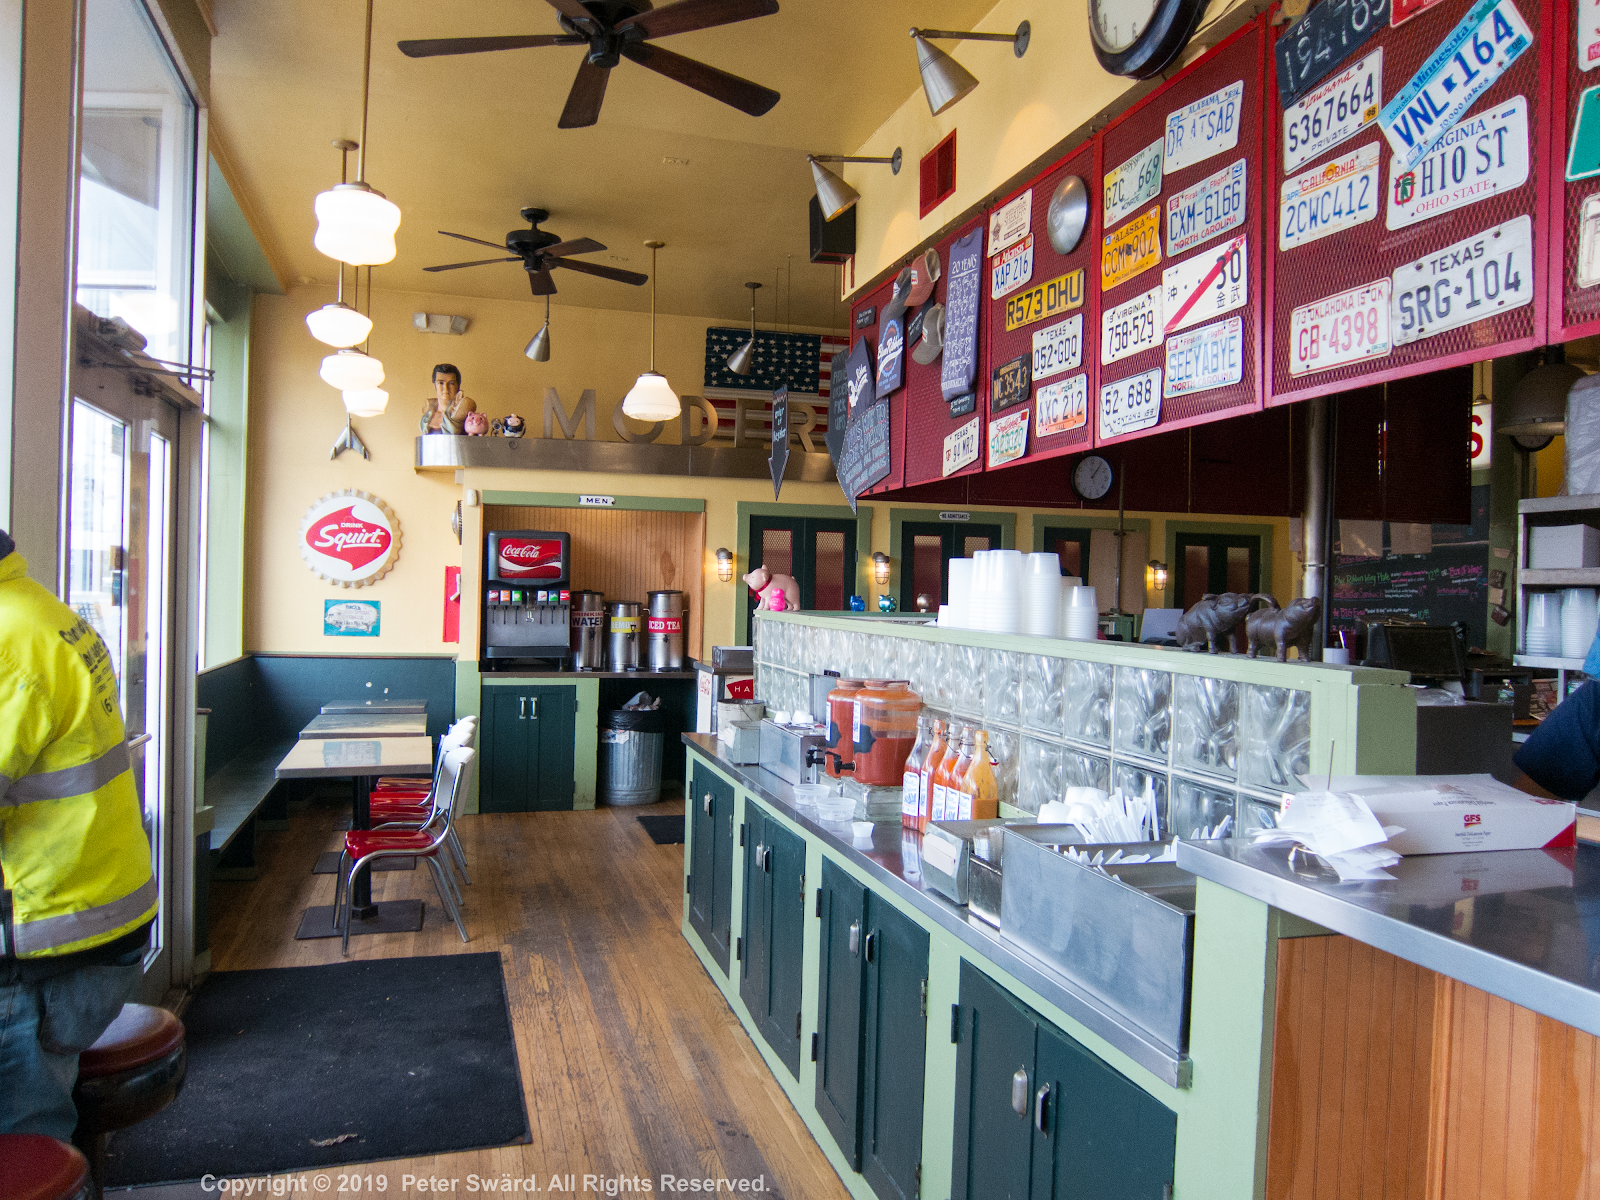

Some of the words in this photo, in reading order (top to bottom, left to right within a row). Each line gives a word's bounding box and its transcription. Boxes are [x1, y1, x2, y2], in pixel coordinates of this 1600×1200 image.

[1411, 25, 1469, 92] Minnesota
[1305, 71, 1355, 110] Louisiana
[1393, 89, 1450, 148] VNL
[1453, 9, 1515, 88] 164
[1463, 77, 1489, 104] lakes
[1189, 94, 1220, 114] ALABAMA
[1289, 73, 1374, 152] S367664
[1311, 124, 1349, 151] PRIVATE
[1430, 119, 1487, 153] IRGINIA
[1476, 126, 1508, 176] ST
[1138, 153, 1160, 189] 669
[1184, 190, 1198, 202] First
[1209, 174, 1228, 189] Flight
[1302, 159, 1355, 192] CALIFORNIA
[1170, 180, 1241, 241] CXM-6166
[1286, 190, 1299, 201] APR
[1286, 174, 1370, 239] 2CWC412
[1416, 194, 1450, 214] OHIO
[1453, 179, 1491, 202] STATE
[1115, 218, 1145, 243] ALASKA
[1173, 233, 1199, 251] NORTH
[1201, 214, 1237, 239] CAROLINA
[1013, 252, 1029, 281] 216
[1430, 240, 1485, 275] TEXAS
[1466, 252, 1521, 309] 104
[1007, 289, 1043, 327] R573
[1047, 273, 1081, 312] DHU
[1117, 301, 1146, 320] VIRGINIA
[1310, 295, 1354, 321] OKLAHOMA
[1357, 291, 1366, 306] IS
[1371, 286, 1384, 302] OK
[1046, 325, 1067, 342] TEXAS
[1169, 335, 1237, 383] SEEYABYE
[1105, 389, 1119, 416] 52
[1128, 378, 1152, 410] 688
[1171, 379, 1196, 393] NORTH
[1198, 371, 1234, 387] CAROLINA
[1063, 390, 1083, 420] 212
[954, 426, 969, 442] TEXAS
[314, 524, 385, 551] Squirt
[649, 621, 664, 630] ICED
[666, 621, 680, 630] TEA
[1464, 814, 1481, 822] GFS
